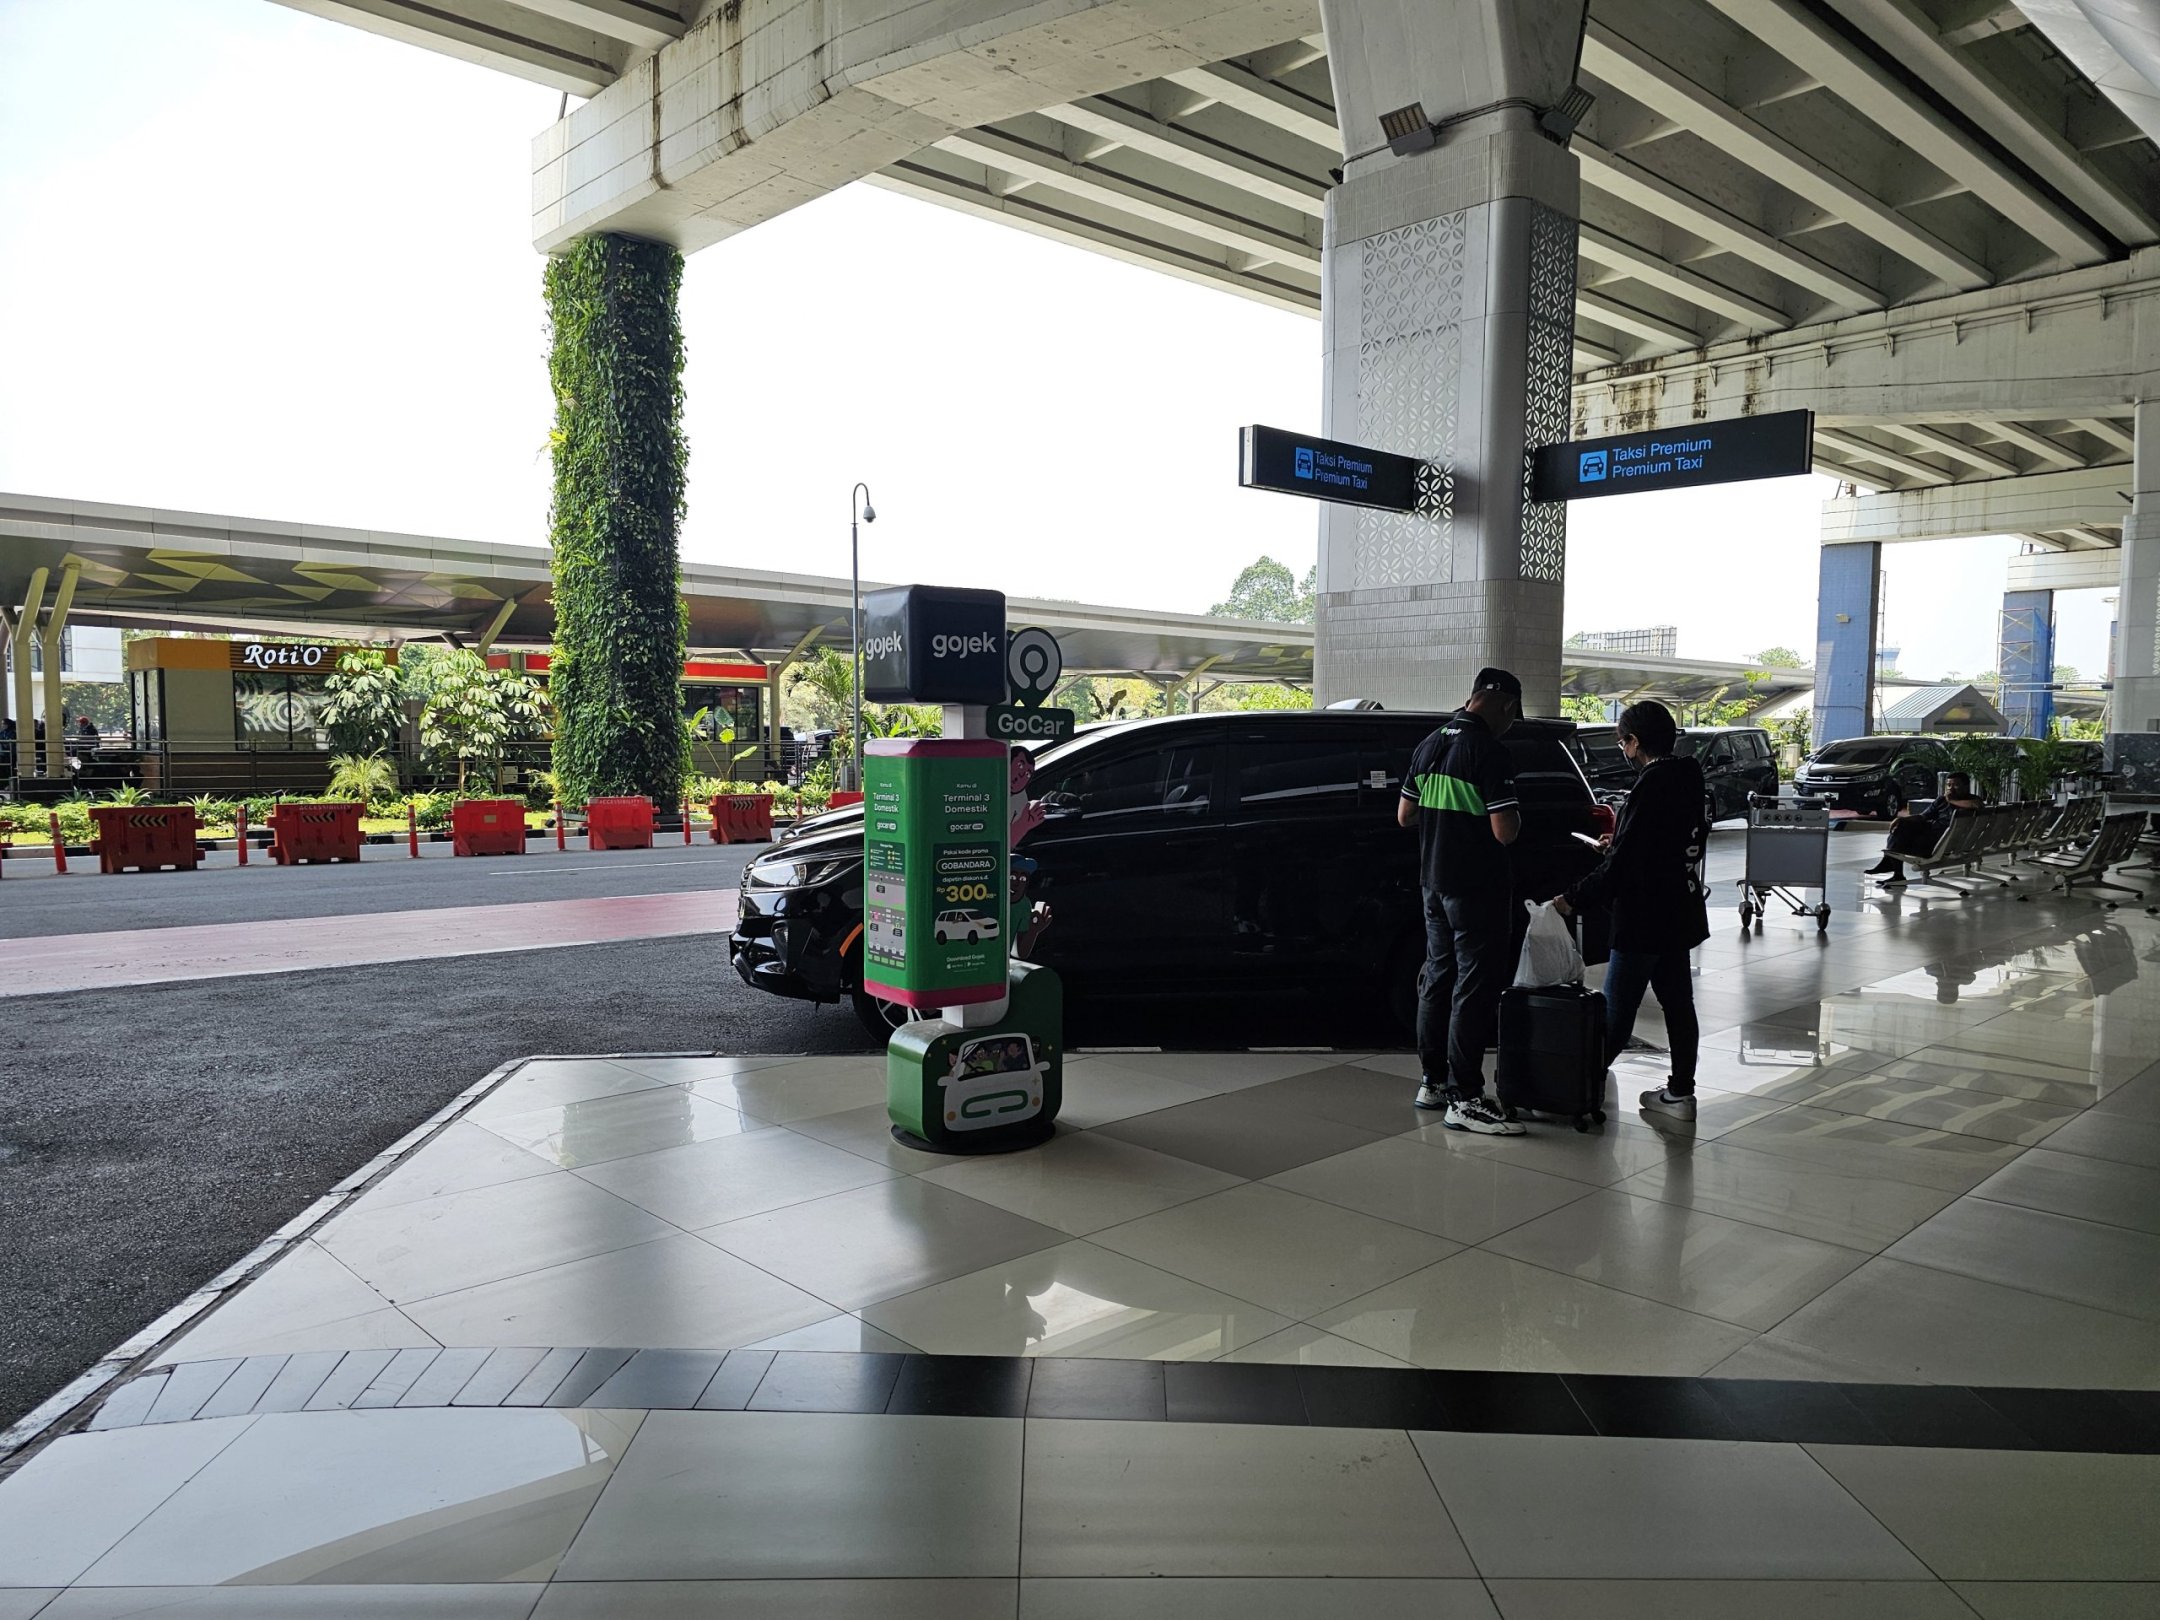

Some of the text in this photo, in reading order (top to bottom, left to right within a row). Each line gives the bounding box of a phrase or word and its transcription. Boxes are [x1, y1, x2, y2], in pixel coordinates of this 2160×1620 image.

[1612, 438, 1712, 462] Taksi Premium
[1314, 451, 1373, 474] Taksi Premium
[1612, 454, 1703, 479] Premium Taxi
[1314, 468, 1368, 490] Premium Taxi
[865, 630, 903, 661] gojek
[932, 631, 997, 659] gojek
[998, 713, 1065, 735] GoCar
[873, 792, 900, 802] Terminal 3
[943, 793, 990, 802] Terminal 3
[874, 803, 899, 813] Domestik
[944, 804, 988, 813] Domestik
[950, 823, 972, 833] gocar
[941, 860, 991, 870] GOBANDARA
[946, 883, 987, 902] 300
